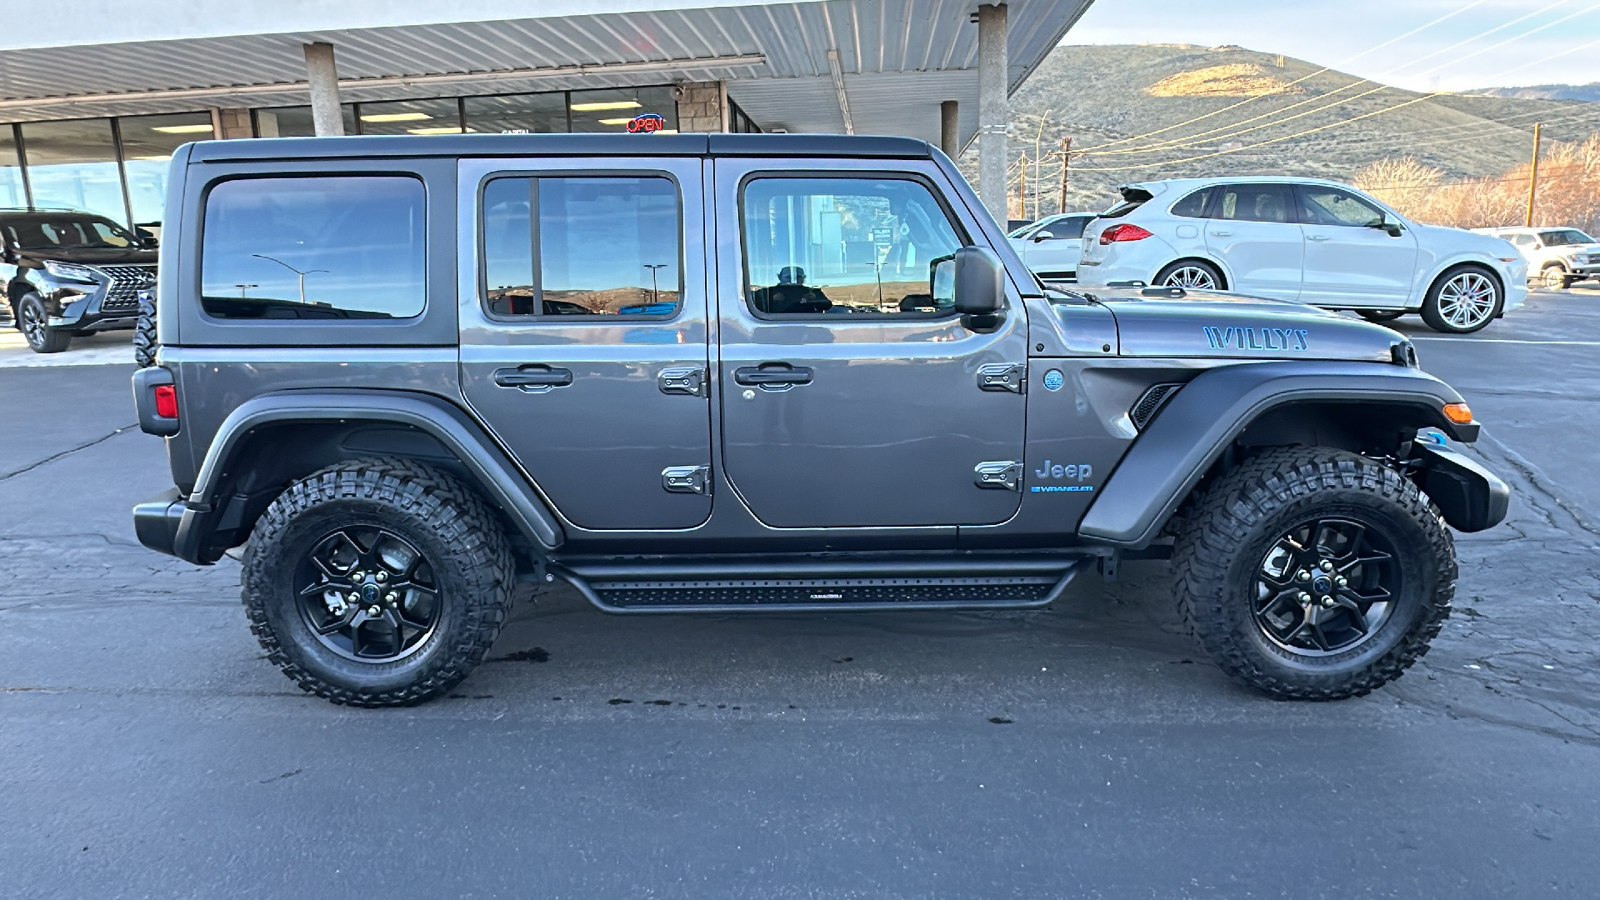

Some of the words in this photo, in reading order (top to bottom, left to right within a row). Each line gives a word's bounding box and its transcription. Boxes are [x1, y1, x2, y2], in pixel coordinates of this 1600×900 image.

[626, 118, 663, 133] OPEN
[1203, 327, 1309, 351] WILLYS
[1035, 460, 1093, 482] Jeep
